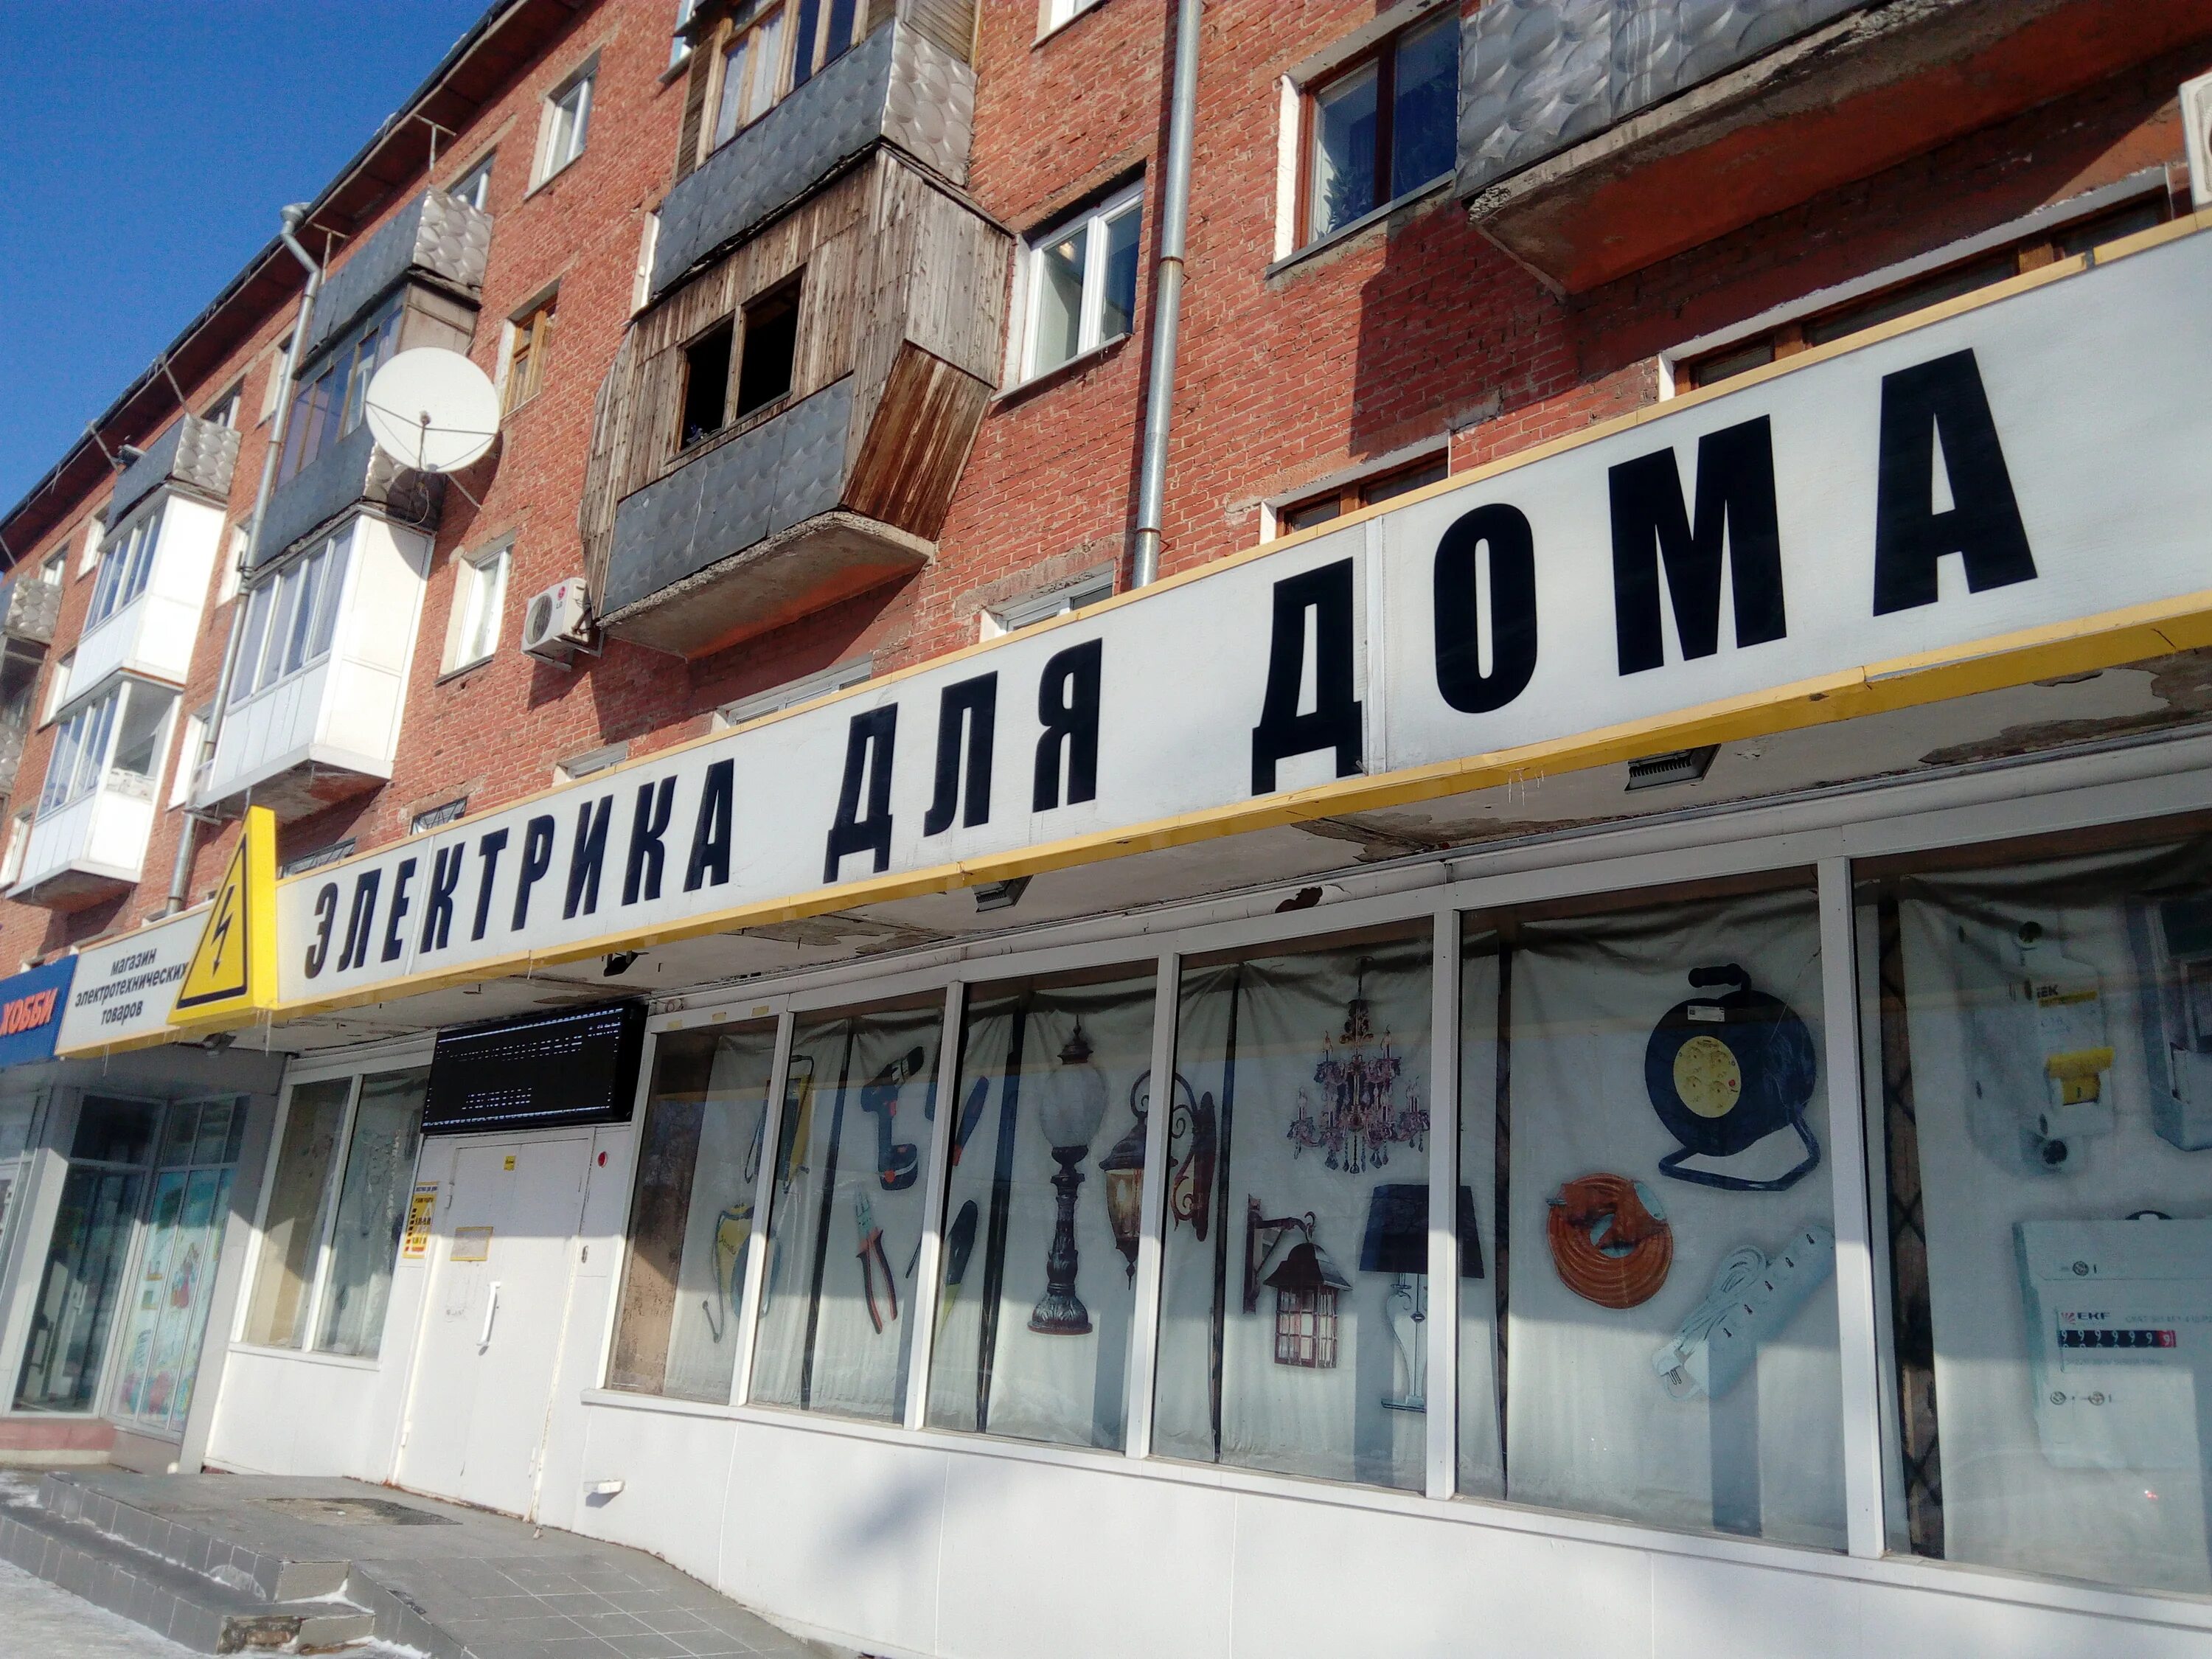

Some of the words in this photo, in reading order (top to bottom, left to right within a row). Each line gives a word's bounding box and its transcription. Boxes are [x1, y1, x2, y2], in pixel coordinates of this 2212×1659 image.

[305, 758, 734, 979] ЭЛЕКТРИКА
[823, 638, 1102, 884] ДЛЯ
[1251, 348, 2037, 796] ДОМА
[111, 947, 156, 976] магазин
[74, 961, 189, 1008] электротехнических
[0, 987, 58, 1037] ХОББИ
[100, 999, 143, 1026] товаров
[2077, 1312, 2110, 1321] EKF
